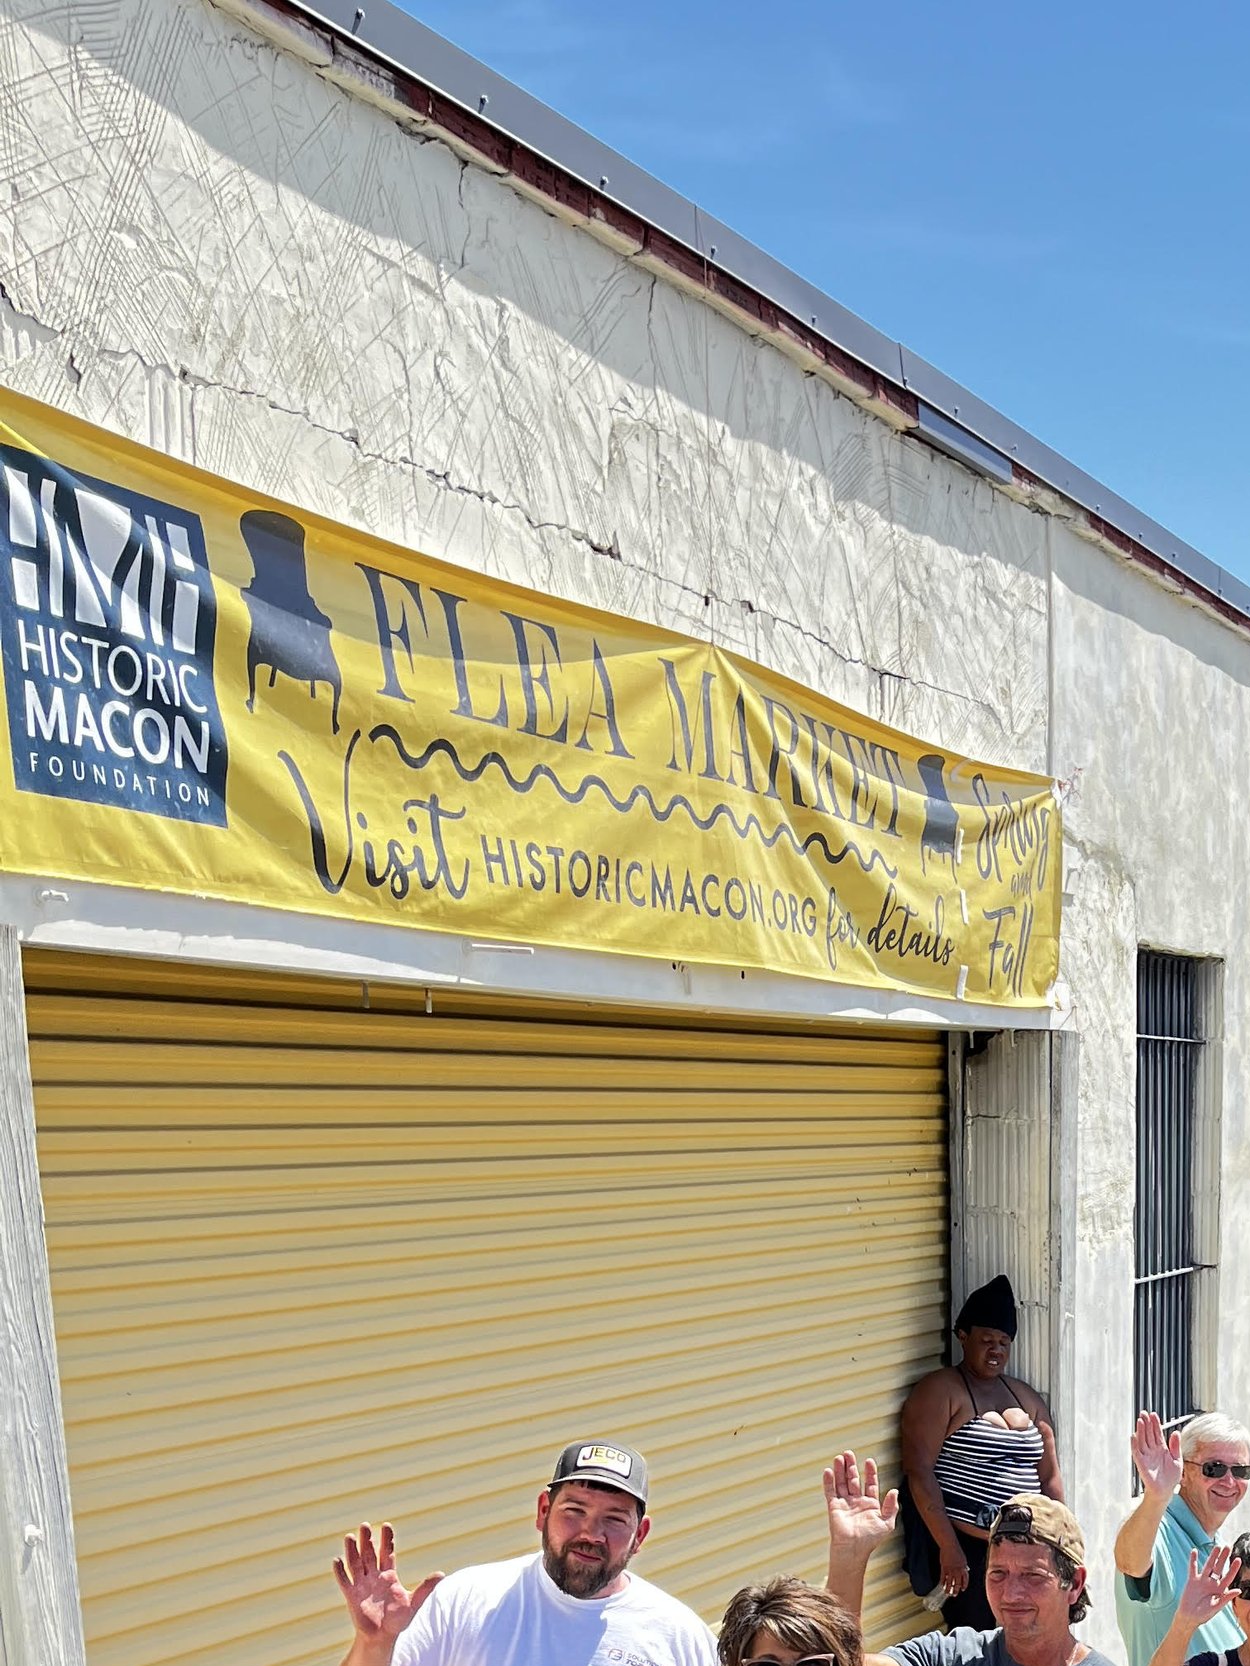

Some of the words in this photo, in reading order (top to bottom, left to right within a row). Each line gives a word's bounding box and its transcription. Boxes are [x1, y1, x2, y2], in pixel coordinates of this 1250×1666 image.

[18, 619, 208, 714] HISTORIC
[355, 562, 636, 760] FLEA
[657, 657, 909, 838] MARKET
[24, 680, 210, 775] MACON
[30, 752, 210, 807] FOUNDATION
[277, 728, 470, 900] Visit
[480, 834, 817, 938] HISTORICMACON.ORG
[826, 886, 860, 971] for
[867, 883, 956, 965] details
[972, 773, 1051, 891] Spring
[1010, 858, 1035, 899] and
[983, 902, 1034, 998] Fall
